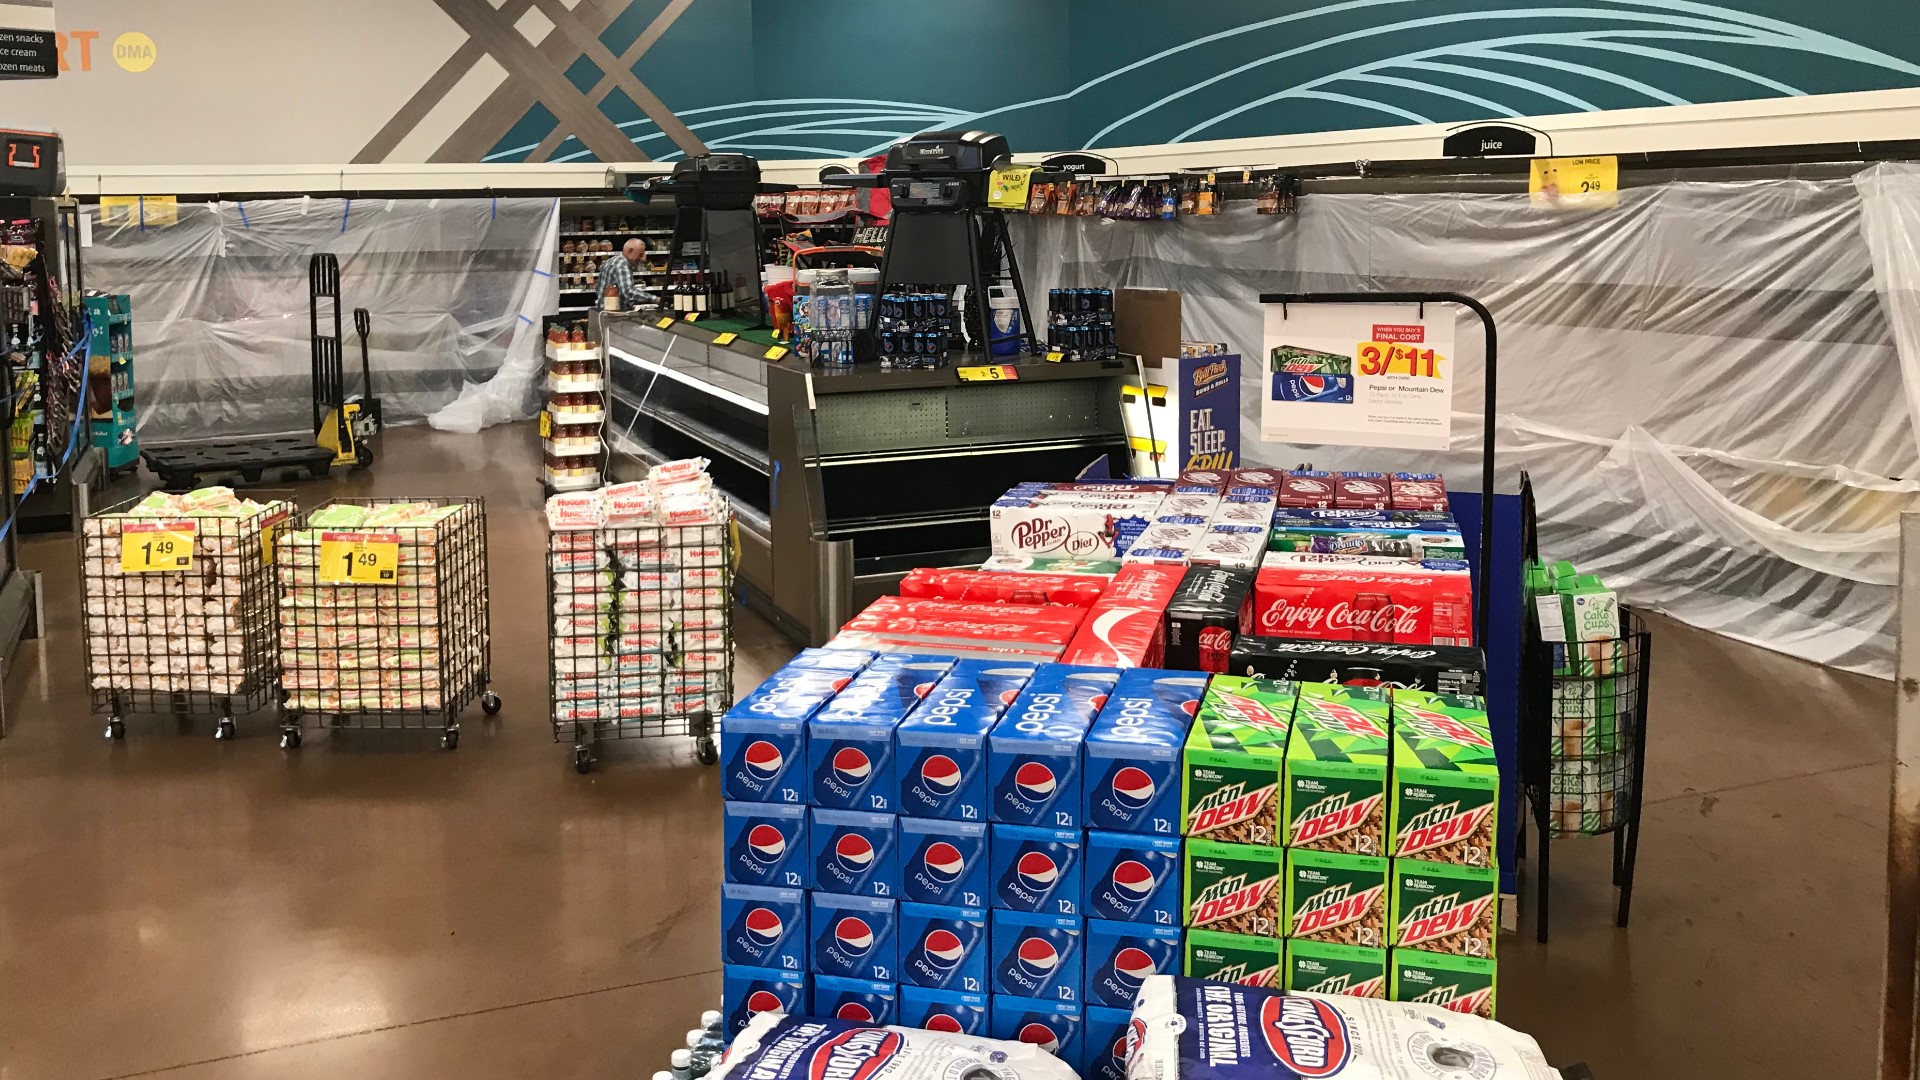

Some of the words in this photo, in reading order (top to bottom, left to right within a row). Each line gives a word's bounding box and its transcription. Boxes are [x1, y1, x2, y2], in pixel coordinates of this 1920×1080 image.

[16, 33, 44, 44] snacks
[11, 48, 37, 57] cream
[116, 44, 153, 59] DMA
[20, 63, 45, 73] meats
[1481, 140, 1502, 151] juice
[1063, 162, 1085, 171] yogurt
[1190, 408, 1215, 433] EAT.
[1190, 430, 1226, 456] SLEEP.
[660, 462, 692, 474] HUGGIES
[606, 484, 638, 496] HUGGIES
[1317, 500, 1328, 508] 12
[1374, 502, 1384, 510] 12
[1433, 503, 1443, 511] 12
[670, 509, 704, 518] HUGGIES
[1018, 520, 1067, 550] Pepper
[1031, 517, 1053, 535] Dr
[142, 541, 152, 565] 1
[156, 541, 174, 554] 49
[1071, 537, 1093, 551] Diet
[342, 552, 353, 576] 1
[358, 553, 377, 566] 49
[1262, 599, 1325, 629] Enjoy
[1583, 609, 1609, 620] Cake
[1583, 620, 1610, 631] Cups
[923, 687, 975, 726] pepsi
[1015, 693, 1063, 732] pepsi
[1111, 697, 1153, 738] pepsi
[735, 770, 764, 793] pepsi
[823, 776, 851, 799] pepsi
[782, 788, 795, 801] 12
[870, 795, 884, 809] 12
[911, 785, 941, 808] pepsi
[1004, 791, 1034, 815] pepsi
[961, 805, 974, 819] 12
[1055, 812, 1069, 826] 12
[1102, 798, 1132, 822] pepsi
[1153, 818, 1168, 833] 12
[1249, 824, 1267, 843] 12
[1354, 834, 1372, 853] 12
[739, 853, 767, 876] pepsi
[1463, 846, 1481, 865] 12
[785, 872, 798, 885] 12
[826, 861, 855, 884] pepsi
[873, 882, 887, 895] 12
[914, 871, 943, 895] pepsi
[963, 892, 977, 906] 12
[1008, 880, 1037, 905] pepsi
[1058, 900, 1072, 914] 12
[1102, 891, 1132, 915] pepsi
[1154, 910, 1168, 923] 12
[1251, 917, 1269, 935] 12
[1356, 926, 1373, 945] 12
[736, 936, 763, 958] pepsi
[1463, 936, 1482, 955] 12
[782, 955, 795, 968] 12
[826, 946, 854, 968] pepsi
[872, 965, 886, 979] 12
[914, 959, 944, 982] pepsi
[1008, 967, 1037, 990] pepsi
[963, 978, 977, 991] 12
[1057, 986, 1071, 999] 12
[1103, 977, 1134, 1000] pepsi
[1204, 985, 1232, 1002] THE
[1206, 1003, 1238, 1067] ORIGINAL
[1274, 998, 1330, 1068] KINGSFORD
